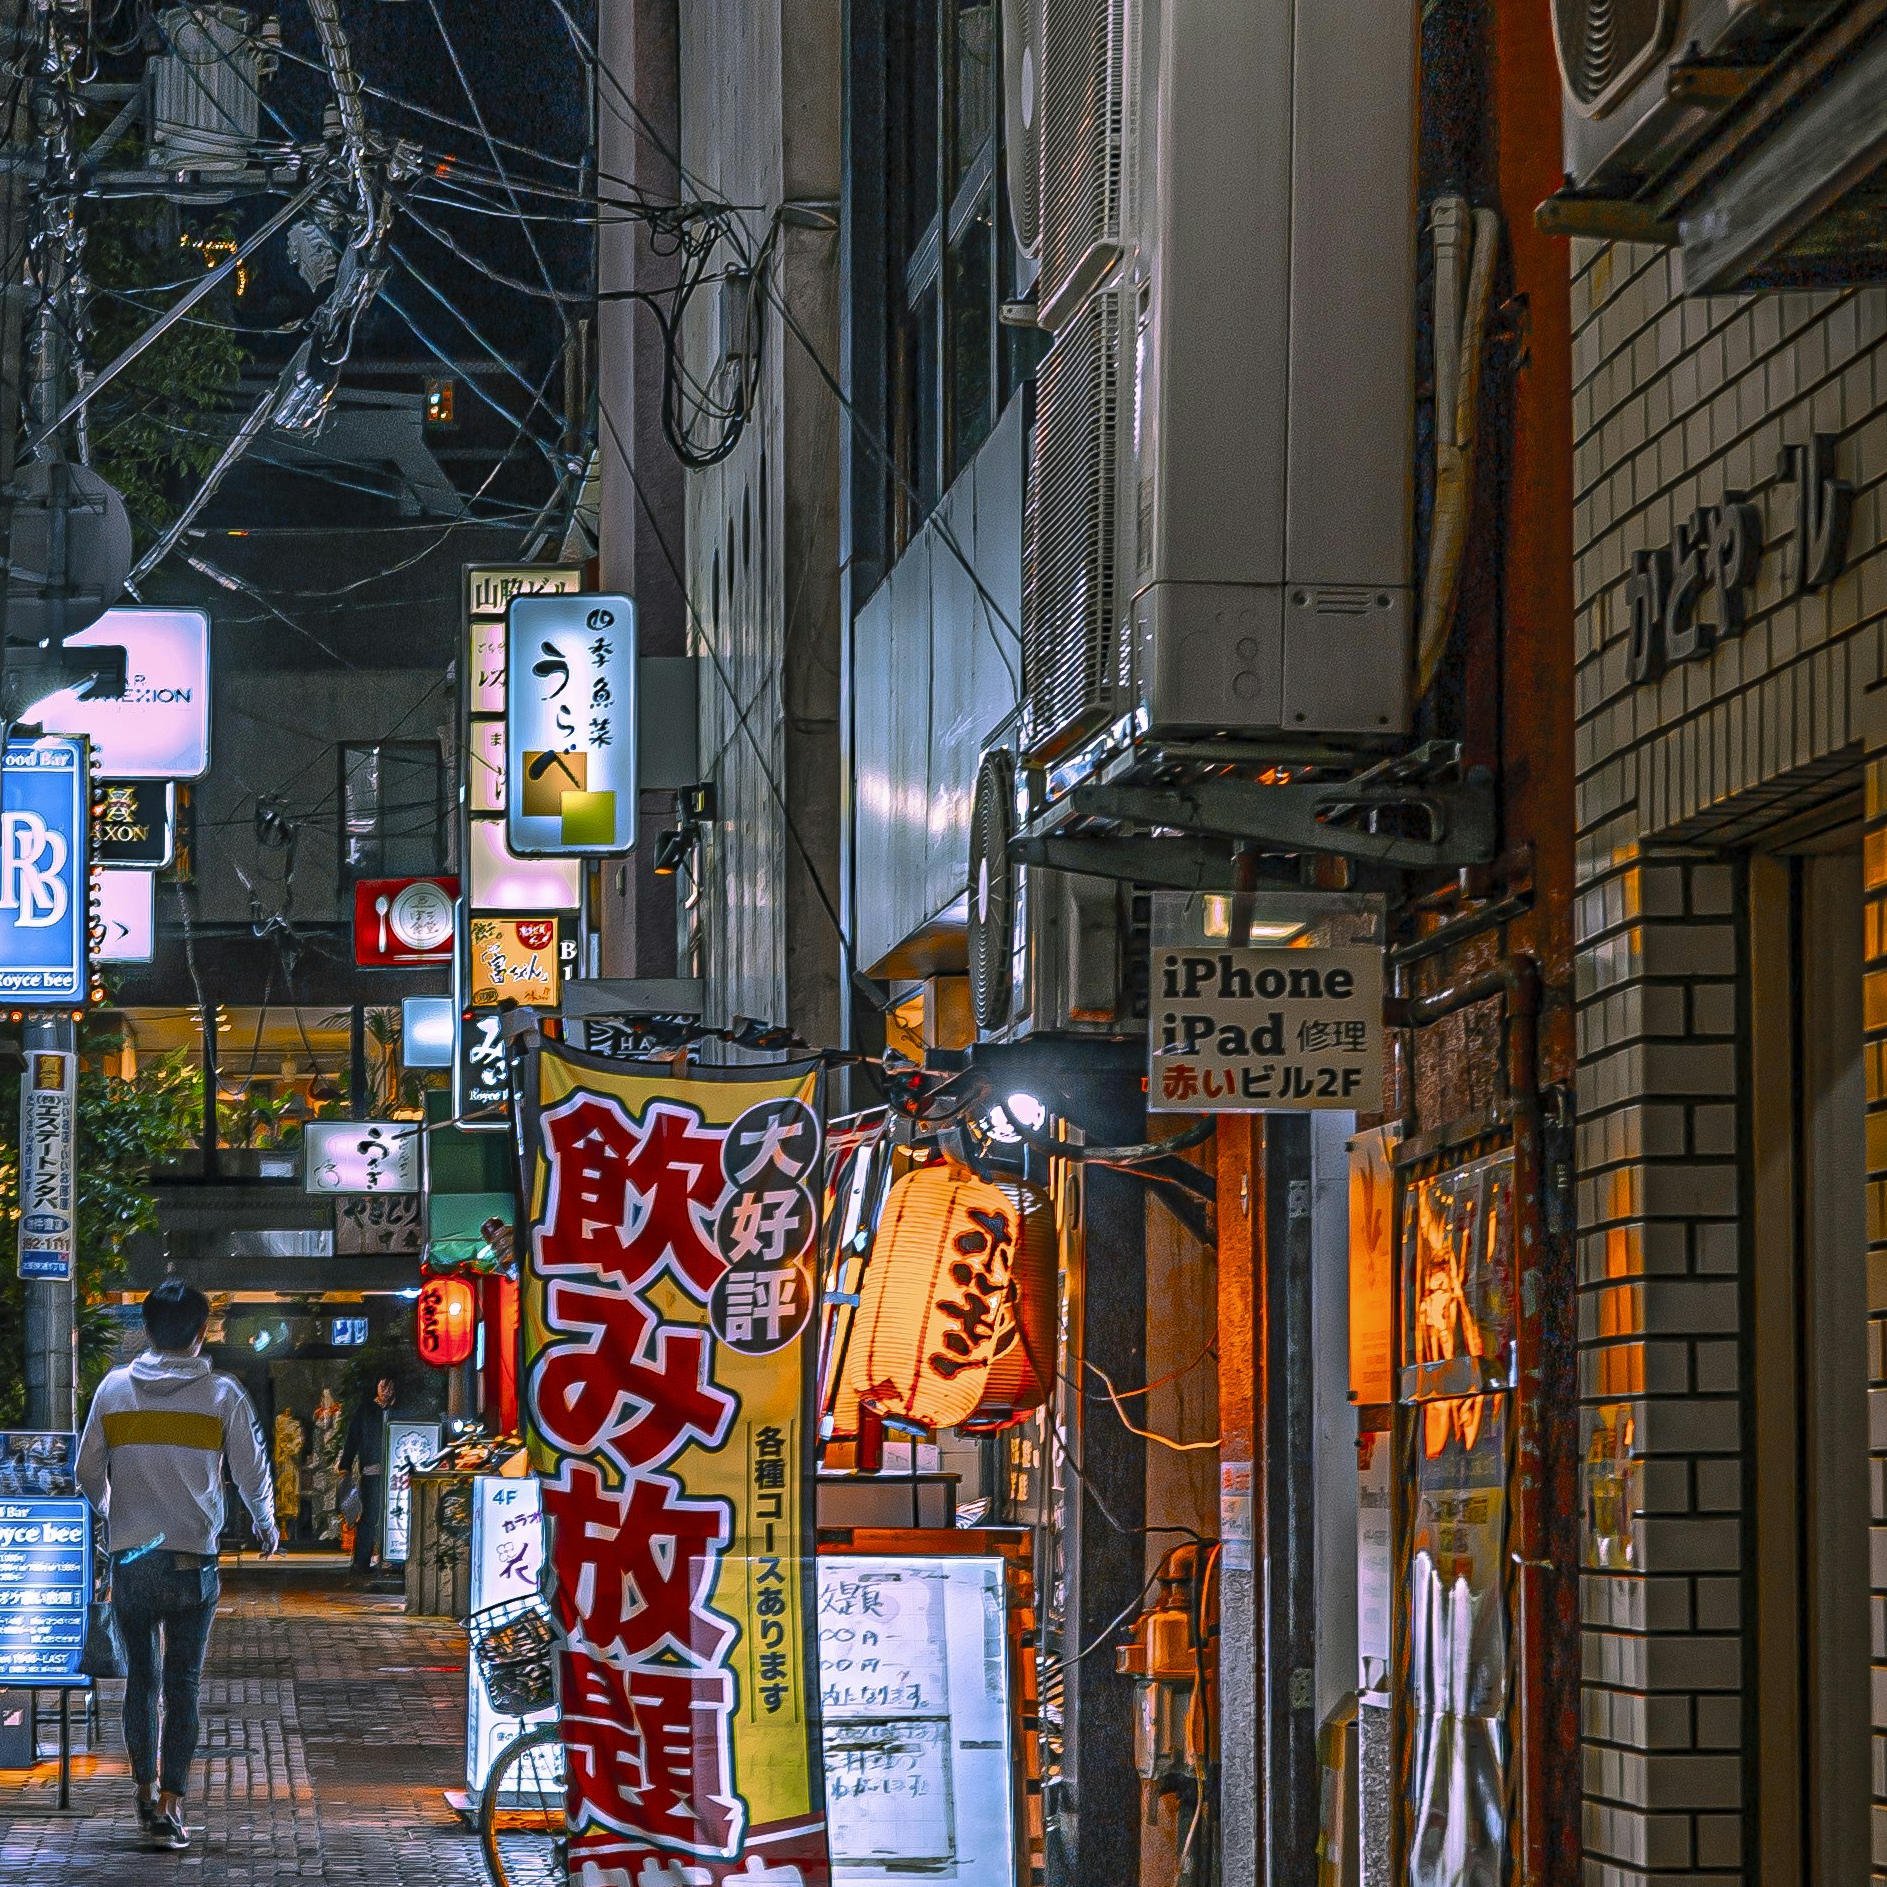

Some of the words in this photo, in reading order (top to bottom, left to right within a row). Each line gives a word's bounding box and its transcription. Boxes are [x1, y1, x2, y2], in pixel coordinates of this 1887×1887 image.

[42, 972, 74, 987] bee
[1162, 955, 1354, 1001] iPhone
[1162, 1012, 1286, 1057] iPad
[1296, 1018, 1367, 1055] 修理
[1161, 1064, 1363, 1102] 赤いビル2F
[722, 1111, 815, 1347] 大好評
[491, 1487, 518, 1506] 4F
[534, 1100, 750, 1856] 飲み放題
[42, 1522, 83, 1543] bee
[752, 1424, 788, 1715] 各種コースあります
